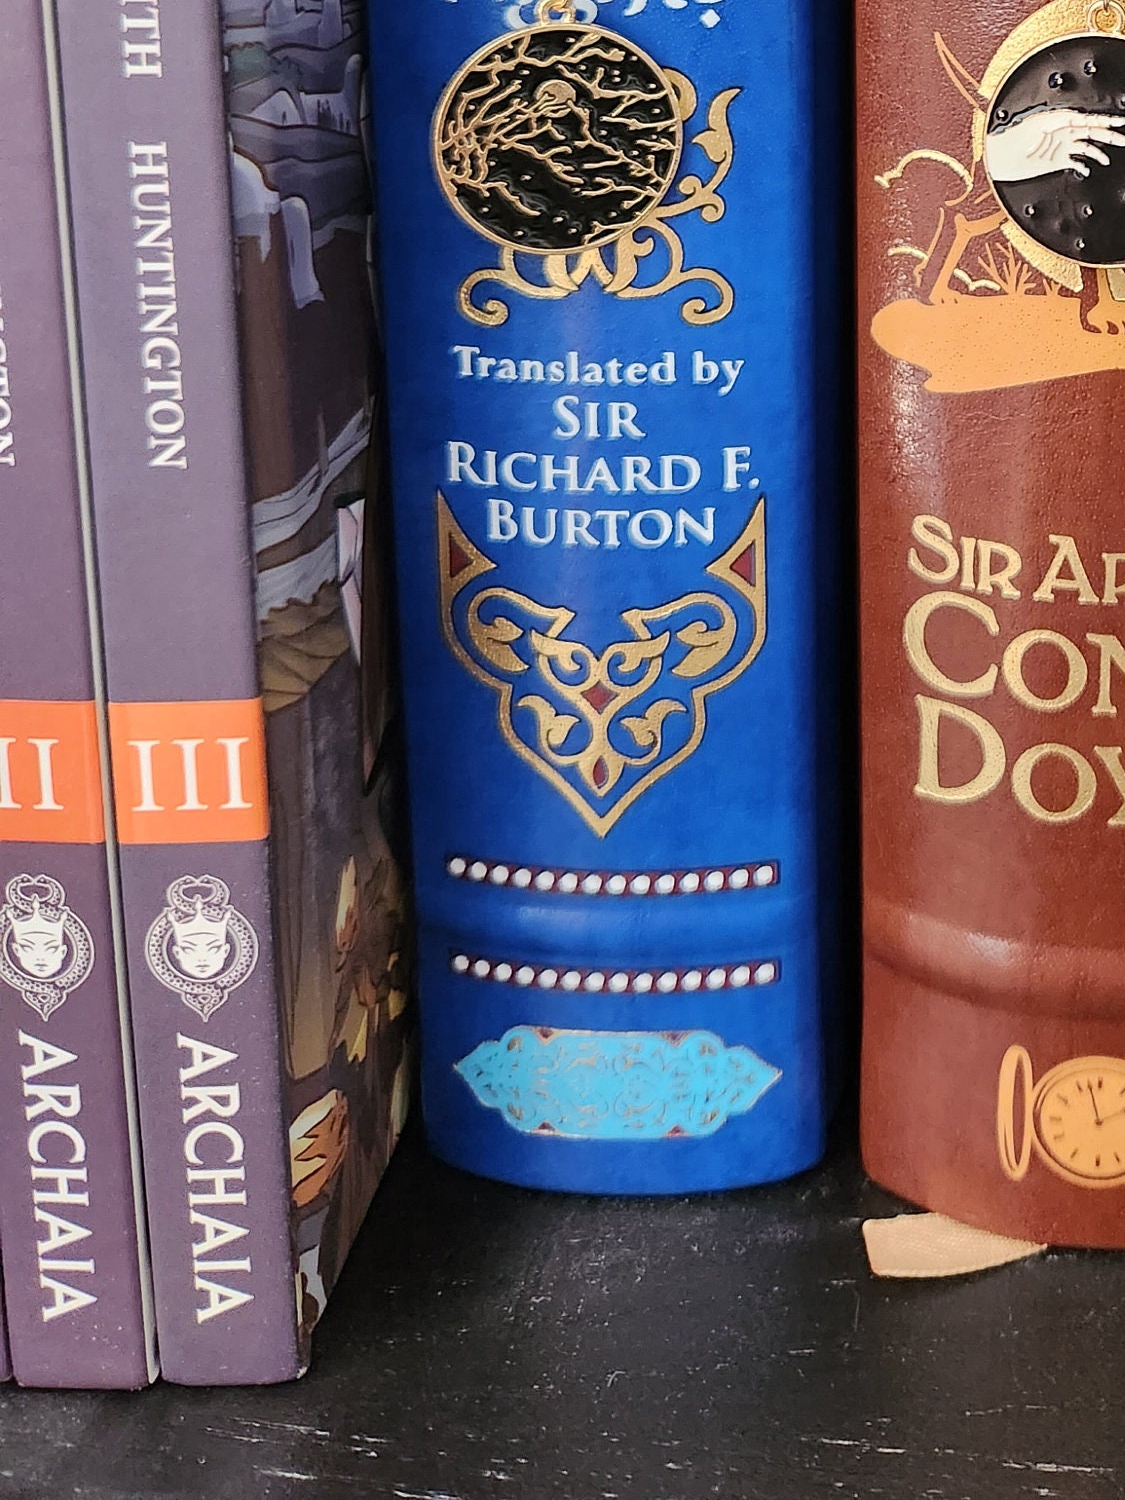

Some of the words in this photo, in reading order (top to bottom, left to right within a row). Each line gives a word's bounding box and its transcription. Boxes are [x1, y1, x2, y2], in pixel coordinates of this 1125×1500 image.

[126, 139, 188, 471] HUNTINGTON
[449, 345, 678, 386] Translated
[691, 350, 746, 397] by
[552, 395, 647, 440] SIR
[446, 440, 701, 494] RICHARD
[721, 446, 761, 493] F.
[486, 497, 717, 550] BURTON
[907, 513, 1023, 601] SIR
[127, 736, 253, 812] III
[17, 1029, 99, 1323] ARCHAIA
[176, 1031, 255, 1324] ARCHAIA
